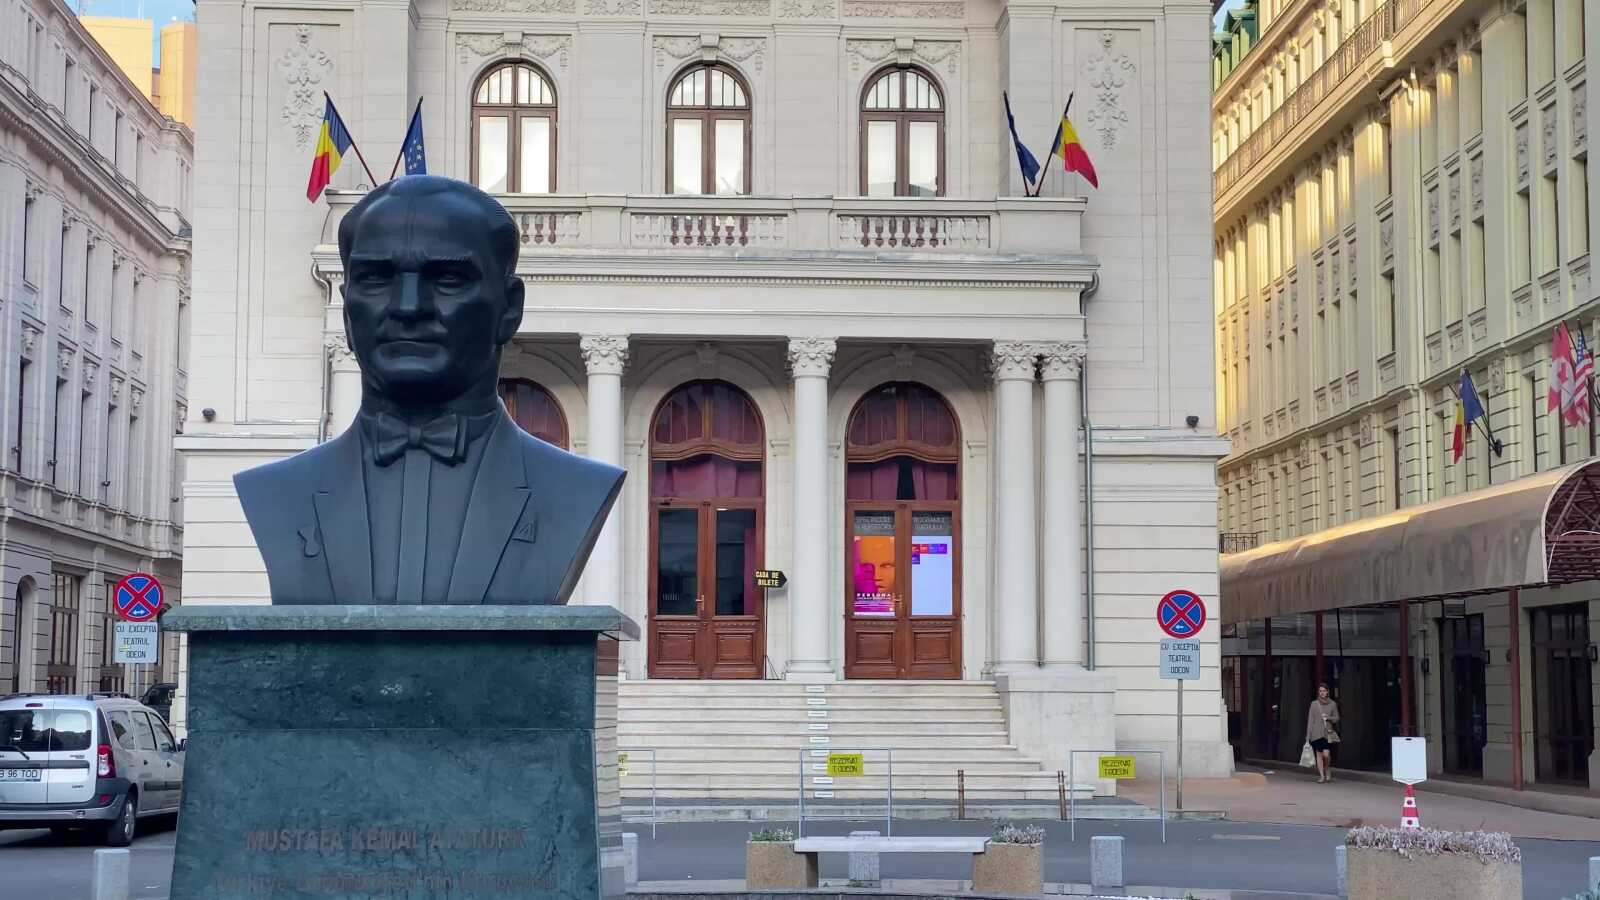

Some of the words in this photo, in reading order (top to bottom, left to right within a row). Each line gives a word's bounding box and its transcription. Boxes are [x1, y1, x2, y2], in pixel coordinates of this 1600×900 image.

[123, 637, 149, 646] TEATRUL
[127, 650, 146, 659] ODEON
[1168, 654, 1192, 663] TEATRUL
[1171, 666, 1190, 674] ODEON
[1101, 759, 1131, 768] REZERVAT
[8, 769, 18, 778] 96
[246, 829, 344, 851] MUSTAFA
[351, 829, 418, 850] KEMAL
